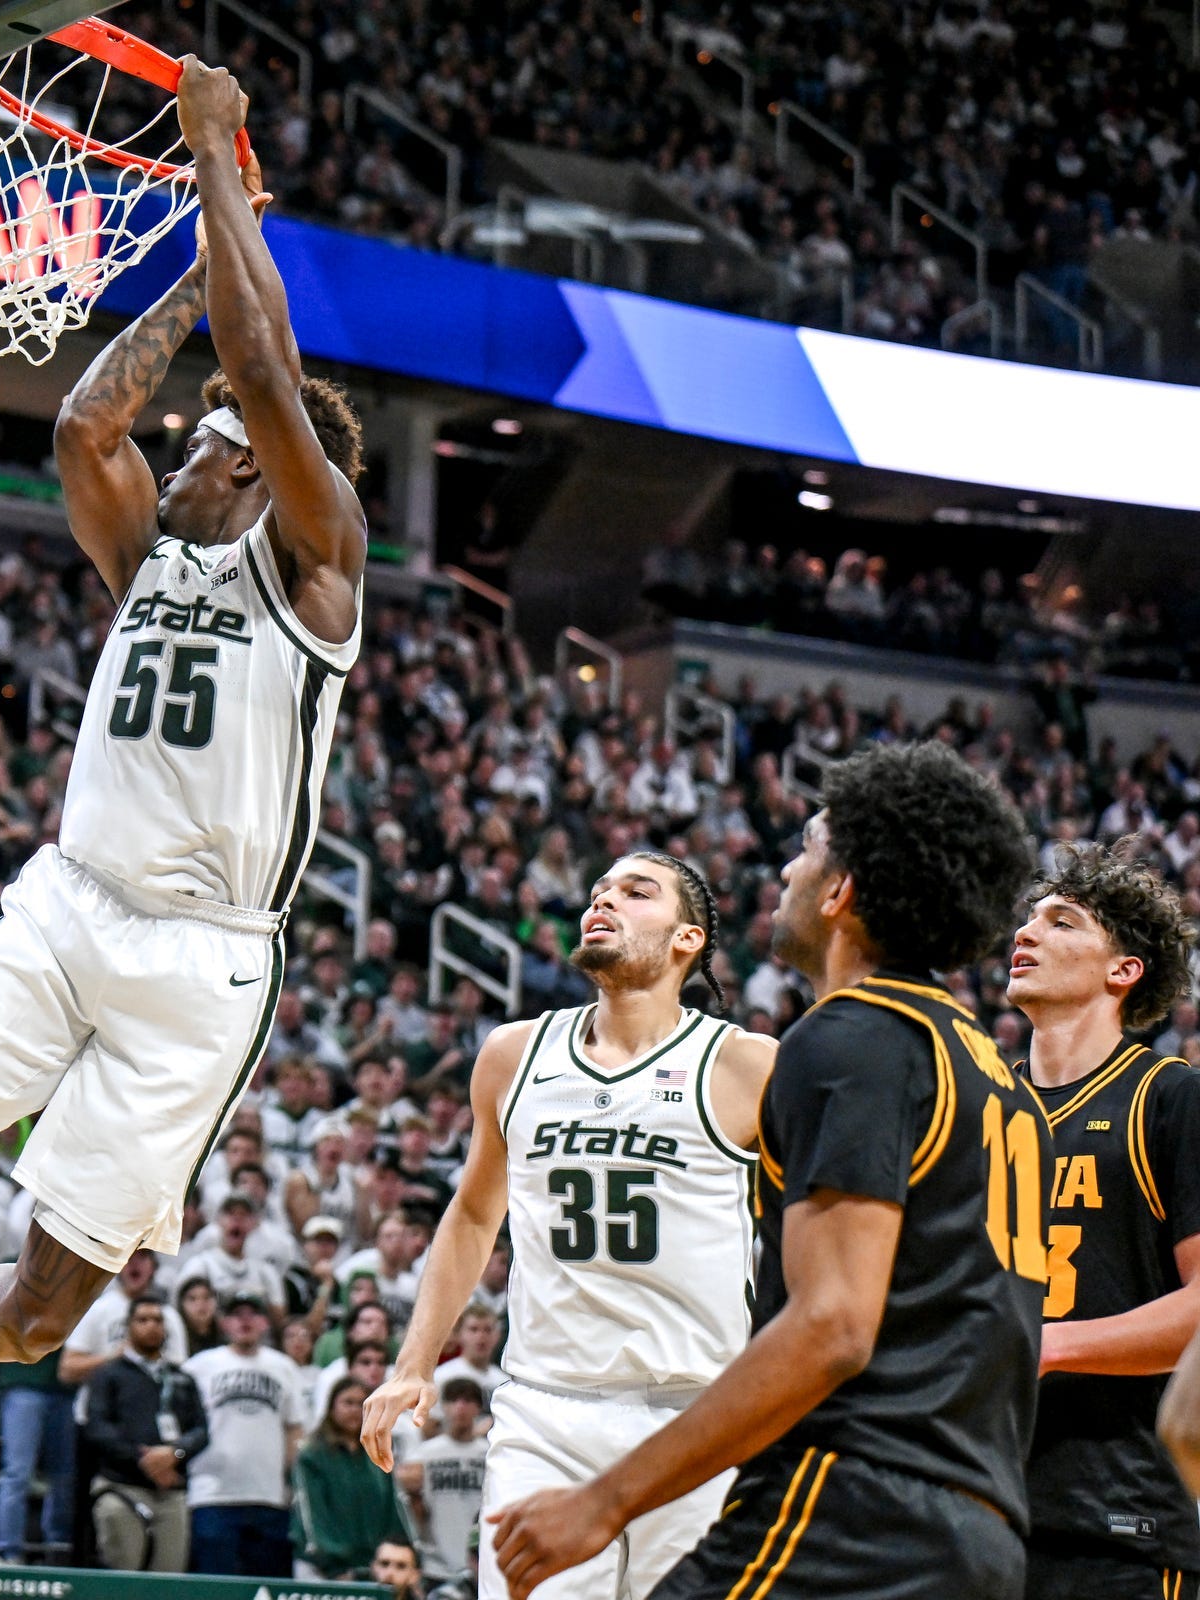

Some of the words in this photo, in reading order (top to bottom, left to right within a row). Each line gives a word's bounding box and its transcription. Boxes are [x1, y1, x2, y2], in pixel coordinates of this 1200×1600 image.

[107, 638, 220, 751] 55
[547, 1167, 659, 1264] 35
[982, 1092, 1049, 1284] 11
